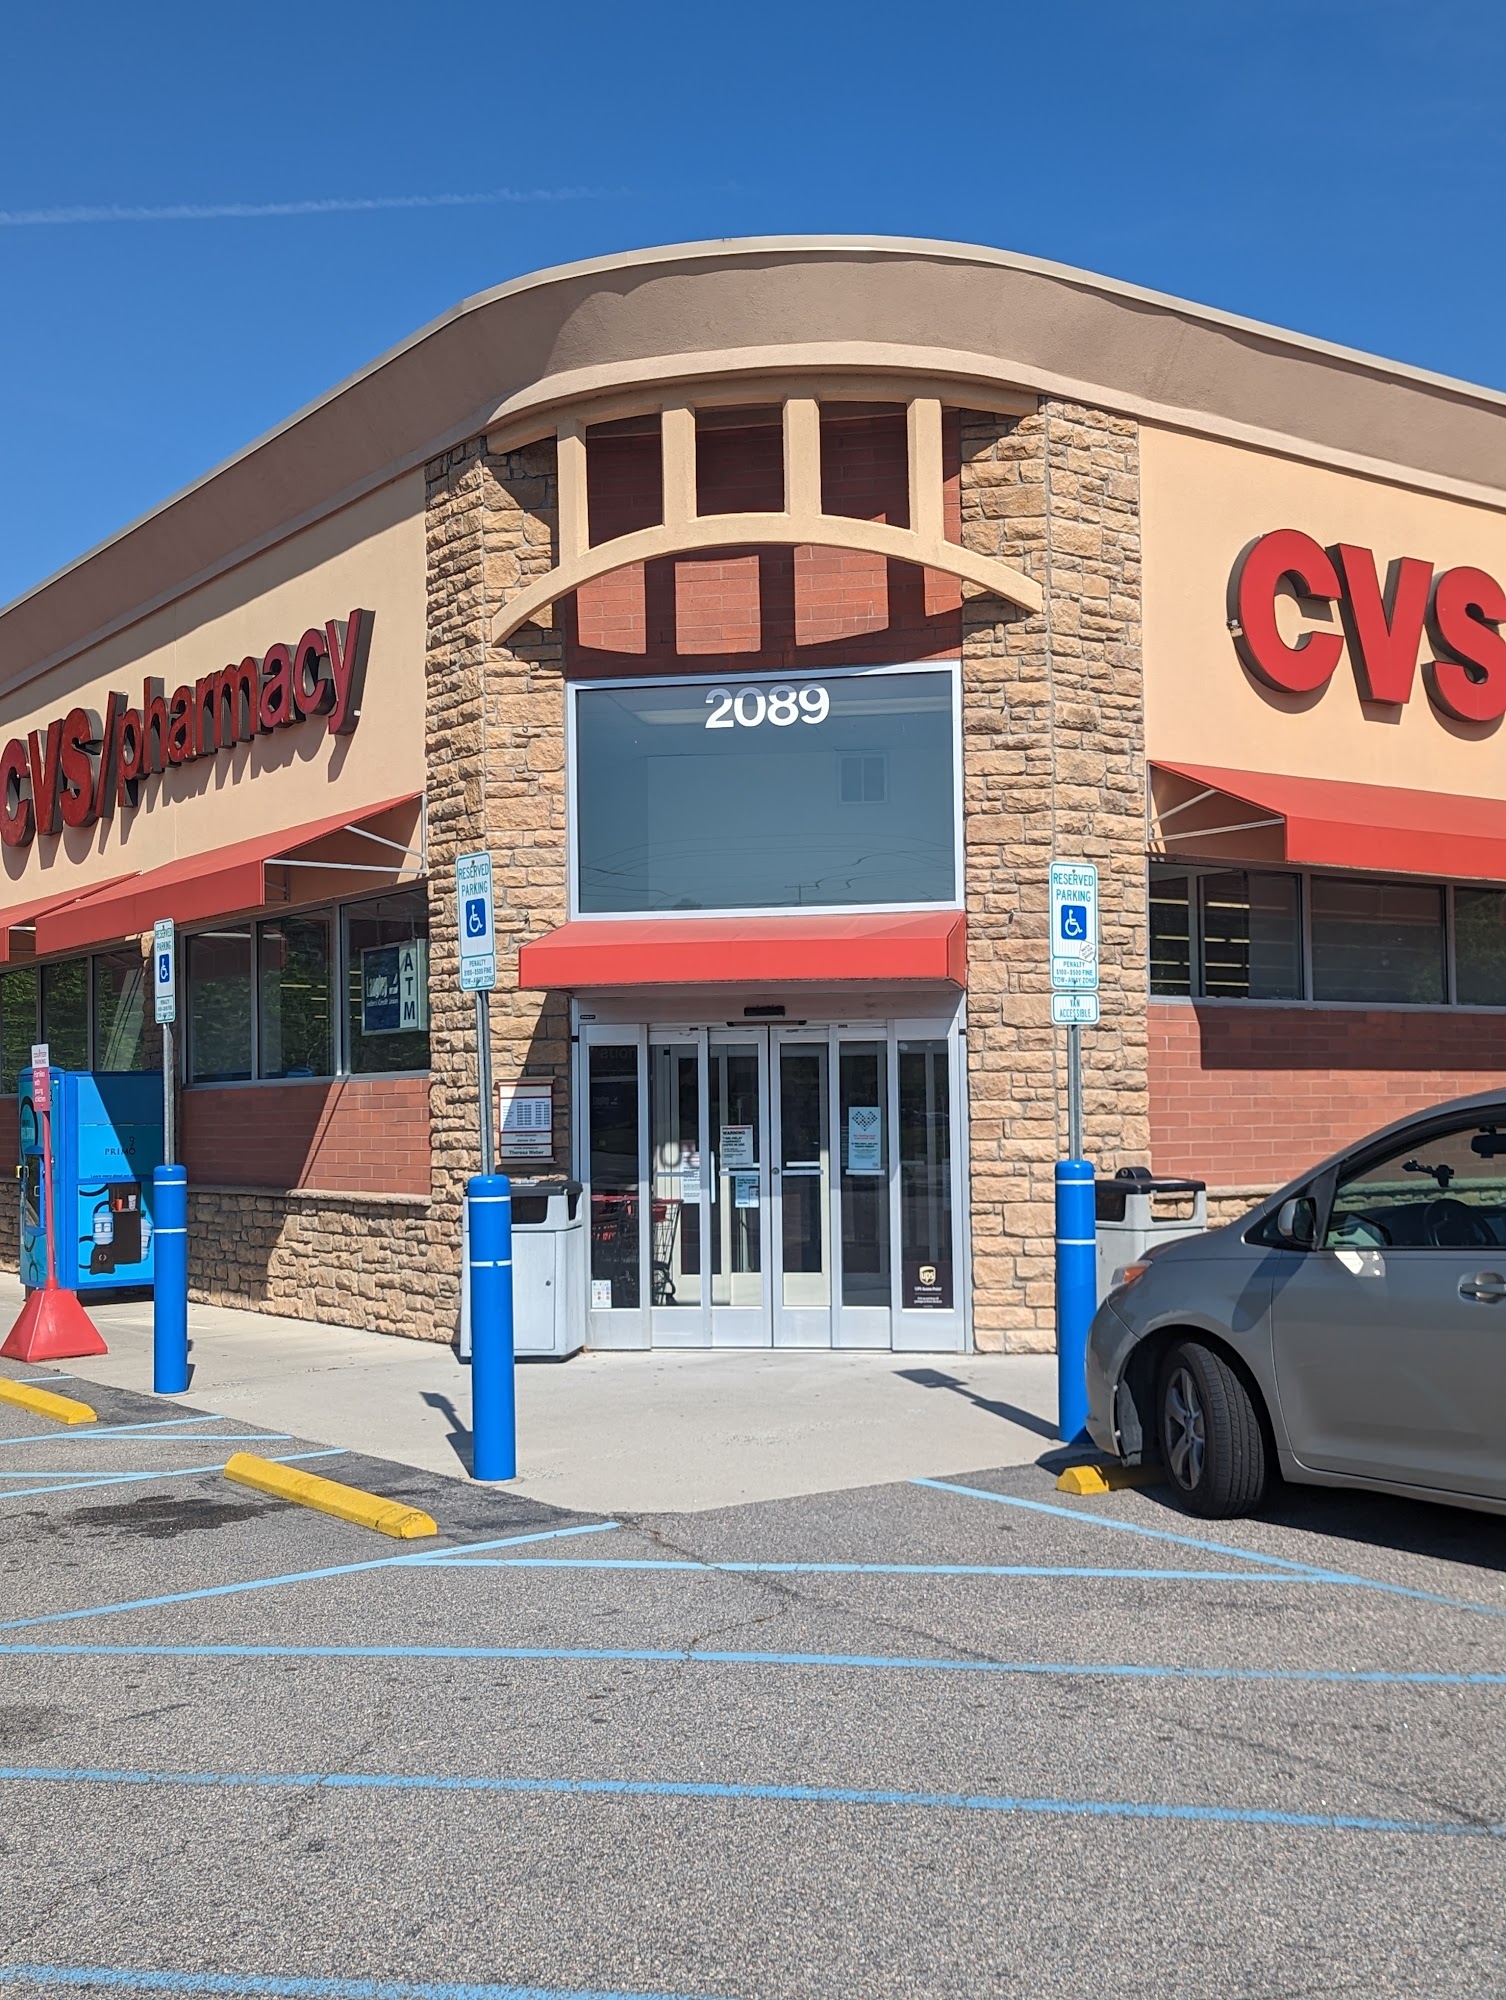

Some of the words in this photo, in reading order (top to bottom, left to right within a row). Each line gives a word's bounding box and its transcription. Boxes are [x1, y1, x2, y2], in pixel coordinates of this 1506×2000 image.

[1229, 528, 1506, 722] CVS
[704, 683, 830, 729] 2089
[0, 608, 372, 847] CVS/pharmacy
[459, 863, 489, 880] RESERVED
[1053, 872, 1094, 887] RESERVED
[461, 881, 488, 897] PARKING
[1056, 889, 1091, 902] PARKING
[469, 959, 486, 967] PENALTY
[1070, 999, 1080, 1007] VAN
[1060, 1009, 1091, 1018] ACCESSIBLE
